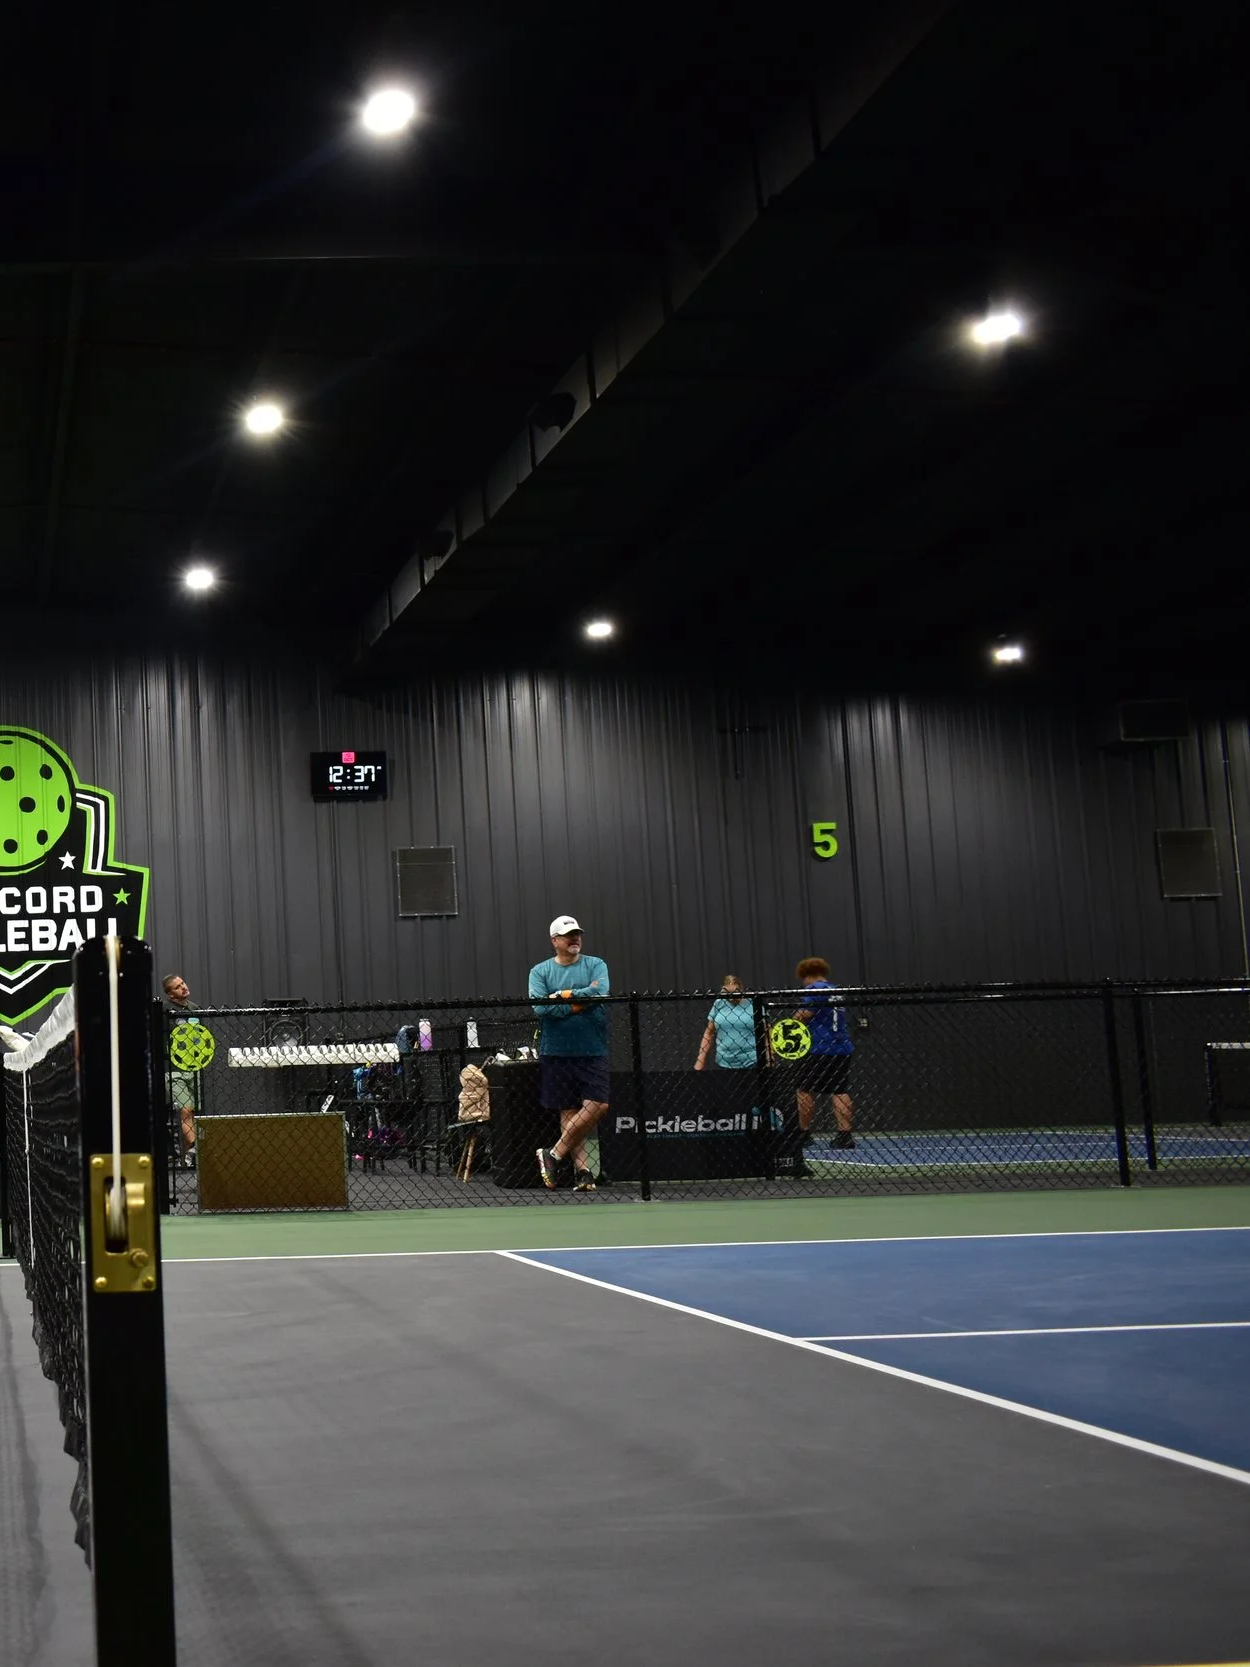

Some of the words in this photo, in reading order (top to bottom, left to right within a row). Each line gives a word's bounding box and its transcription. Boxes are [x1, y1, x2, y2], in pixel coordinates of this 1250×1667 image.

[329, 765, 375, 783] 12:37
[813, 822, 838, 858] 5
[781, 1024, 804, 1052] 5
